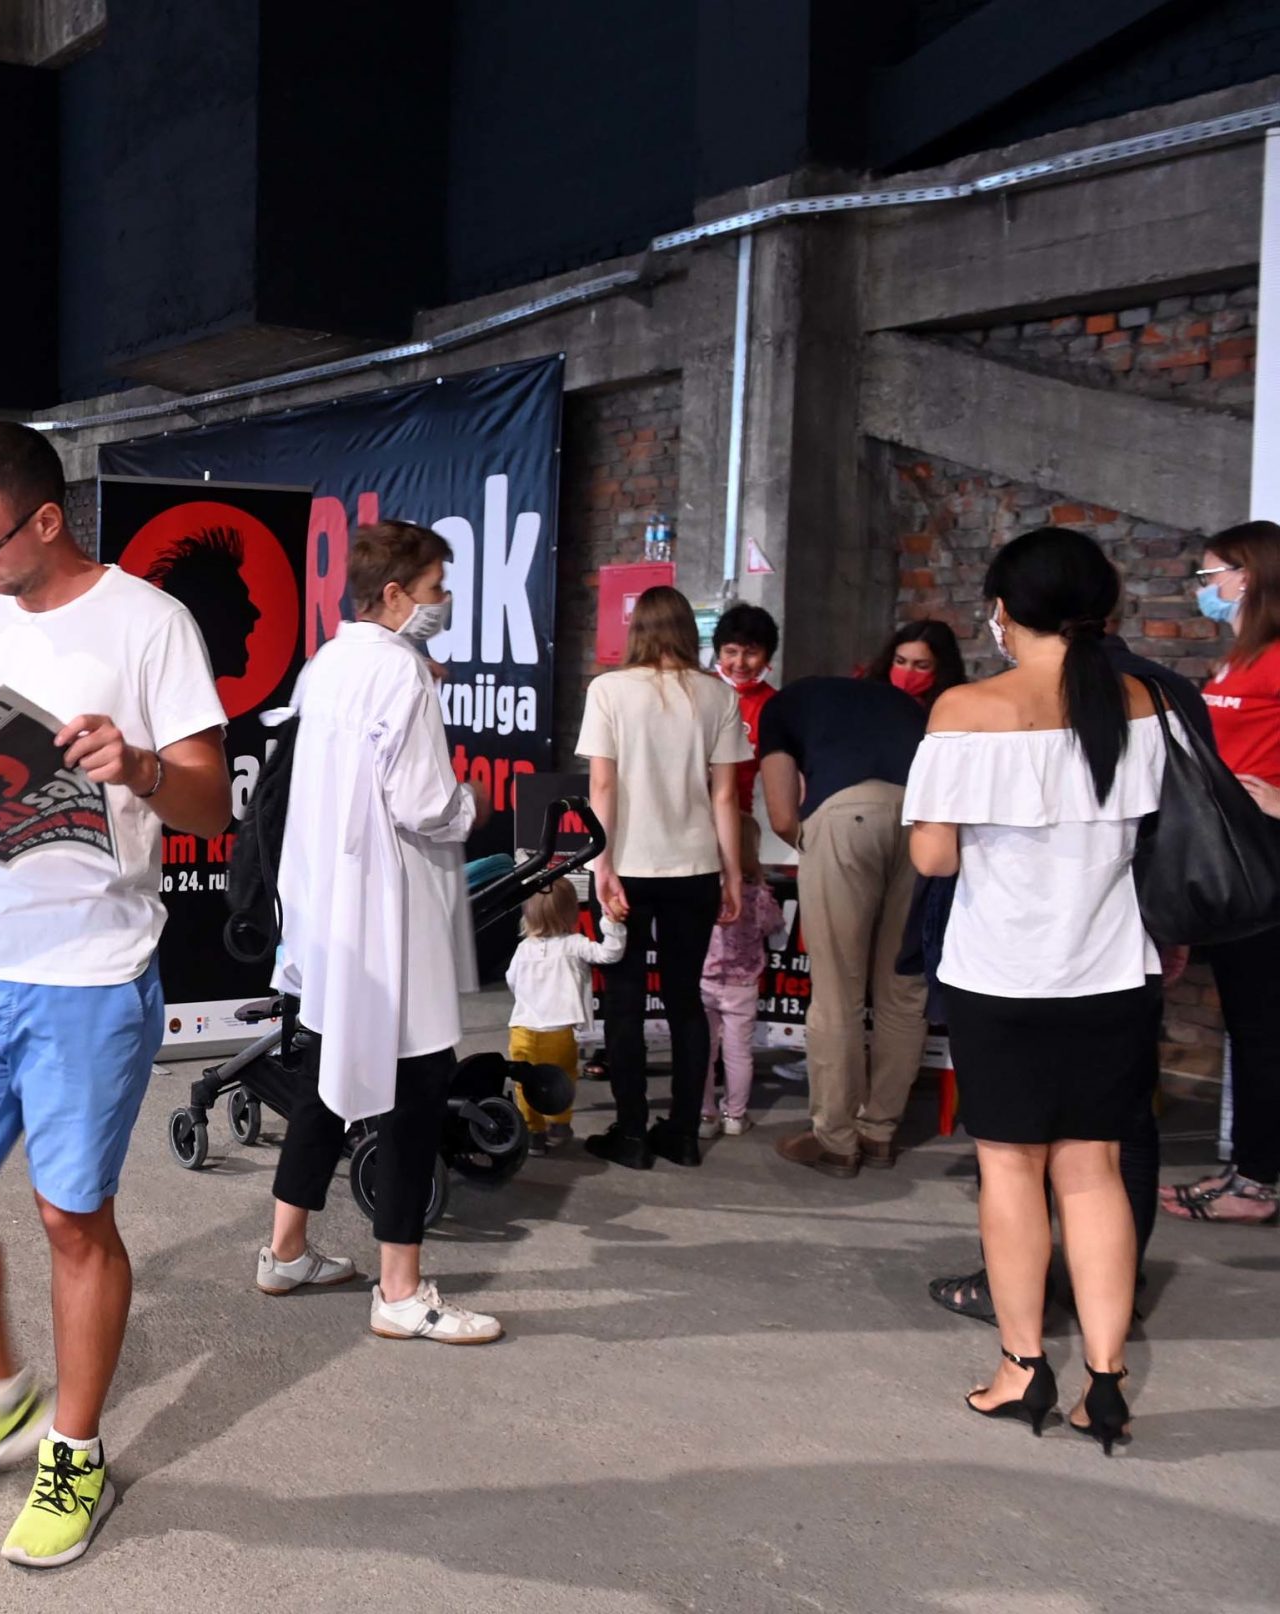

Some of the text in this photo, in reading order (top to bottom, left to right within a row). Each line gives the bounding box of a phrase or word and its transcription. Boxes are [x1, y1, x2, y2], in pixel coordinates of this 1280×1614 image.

[438, 673, 537, 735] knjiga
[178, 870, 204, 891] 24.
[781, 999, 805, 1015] 13.
